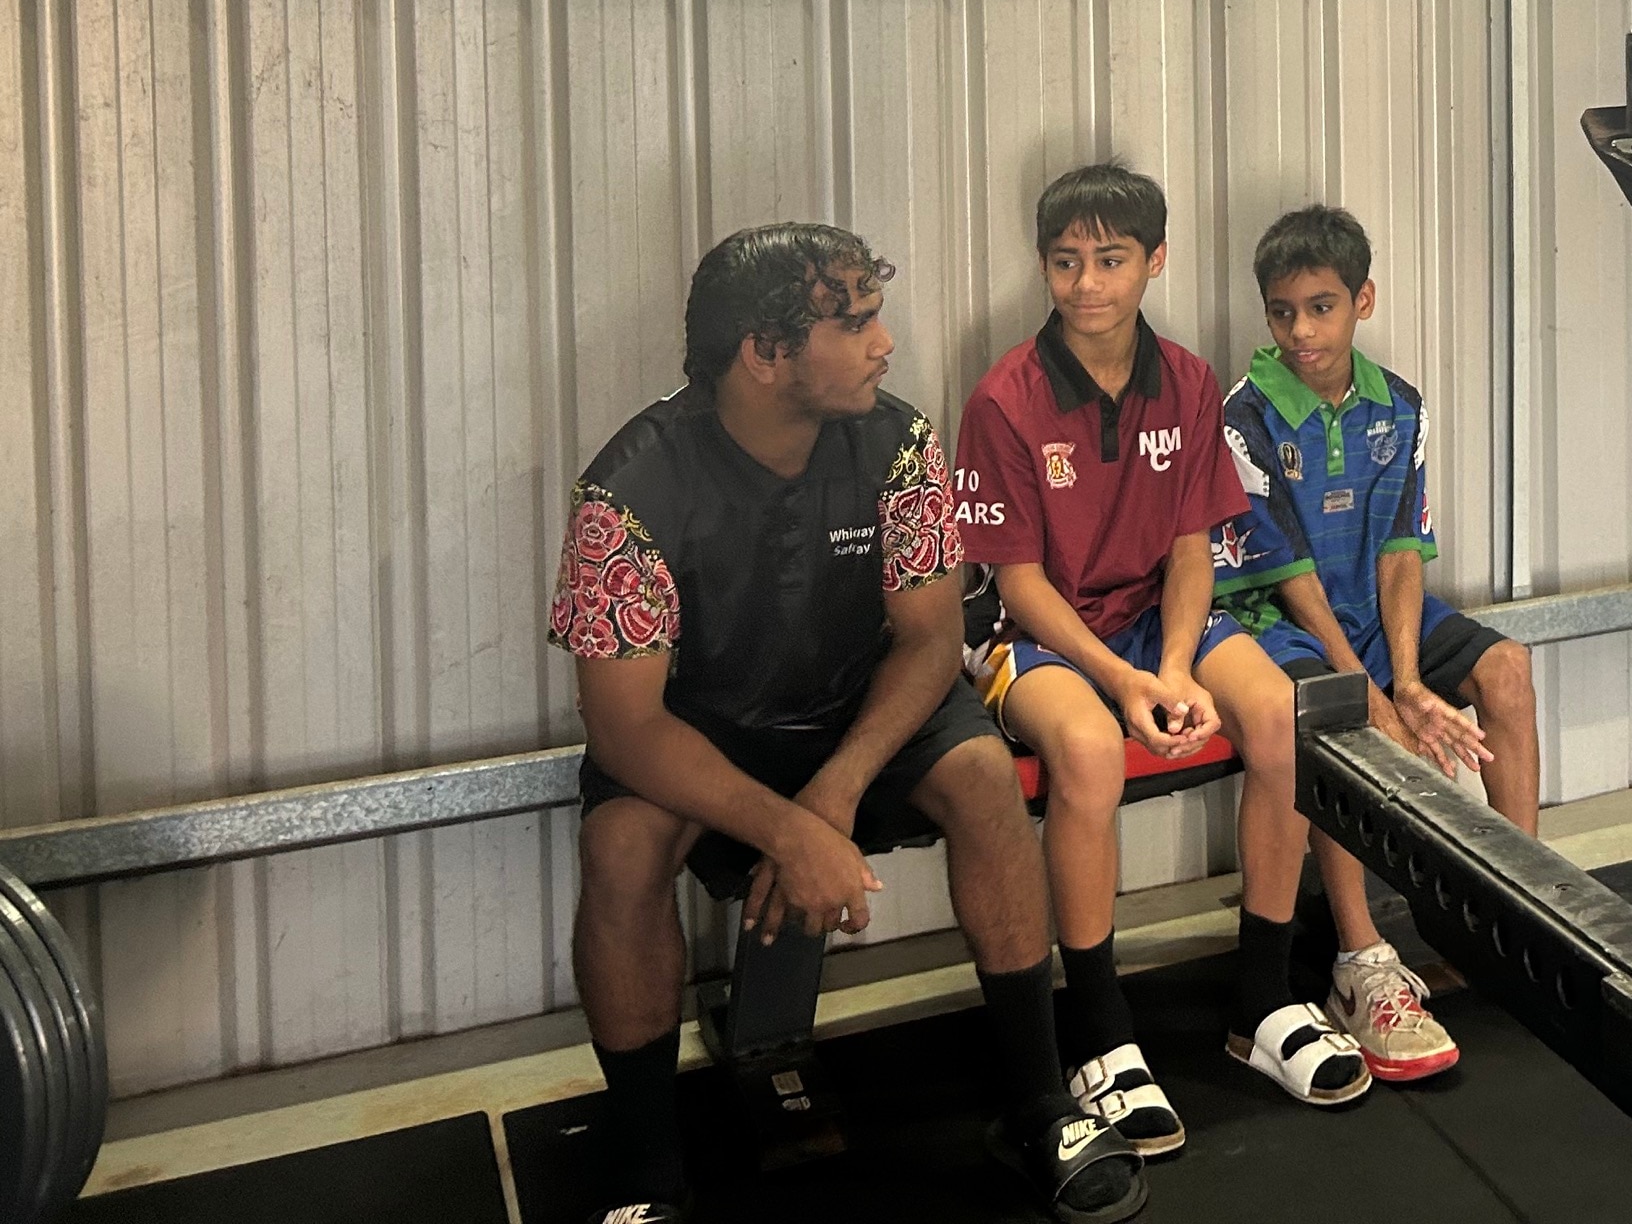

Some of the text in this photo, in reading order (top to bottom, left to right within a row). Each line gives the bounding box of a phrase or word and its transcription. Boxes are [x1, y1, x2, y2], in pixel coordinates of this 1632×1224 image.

[954, 468, 980, 492] 10
[1062, 1118, 1099, 1146] NIKE
[602, 1203, 651, 1224] NIKE
